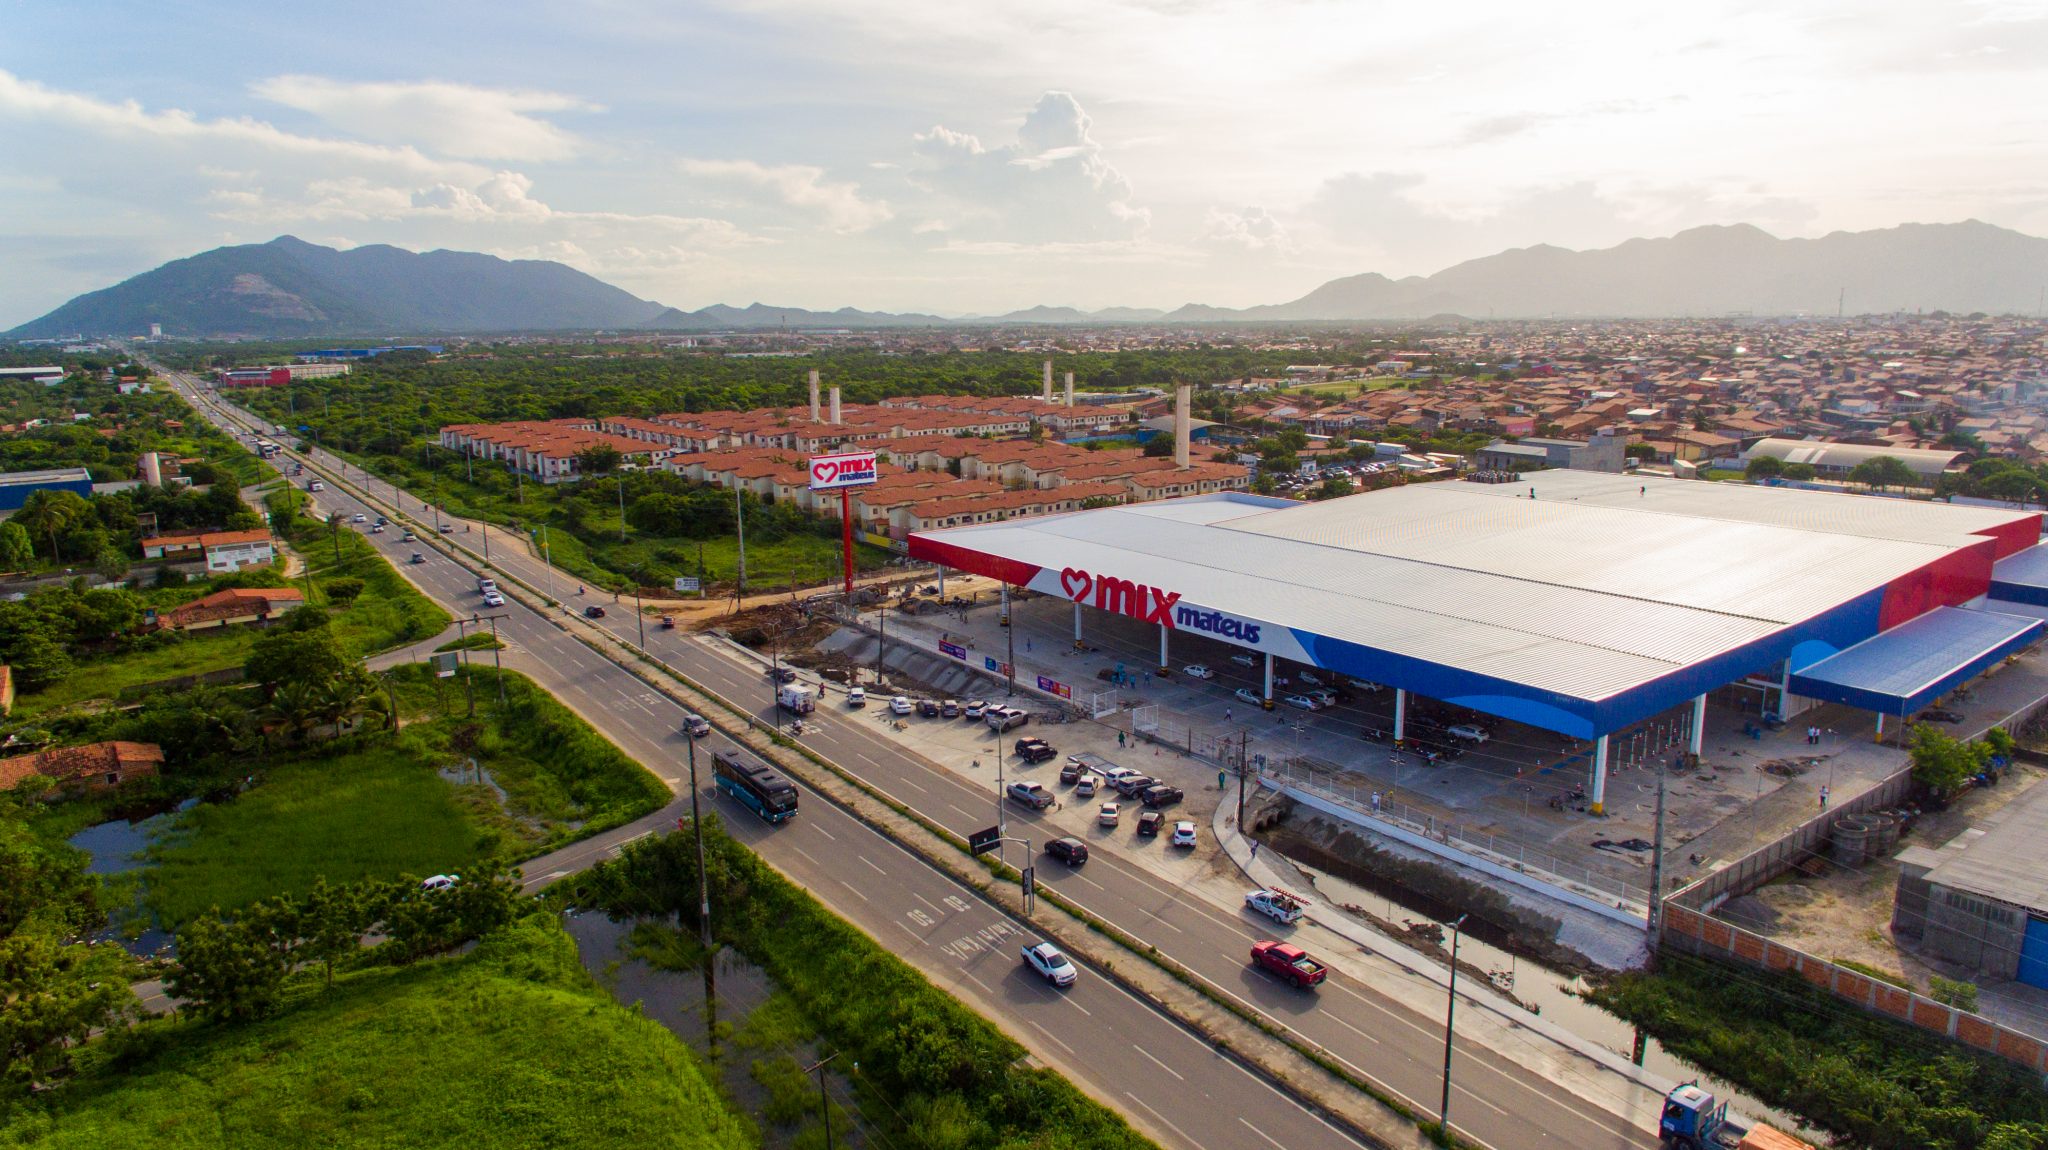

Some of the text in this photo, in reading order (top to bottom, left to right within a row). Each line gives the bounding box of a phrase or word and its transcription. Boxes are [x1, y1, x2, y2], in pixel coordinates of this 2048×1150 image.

[839, 471, 875, 481] mateus
[1096, 574, 1182, 629] mix
[1177, 606, 1261, 643] mateus
